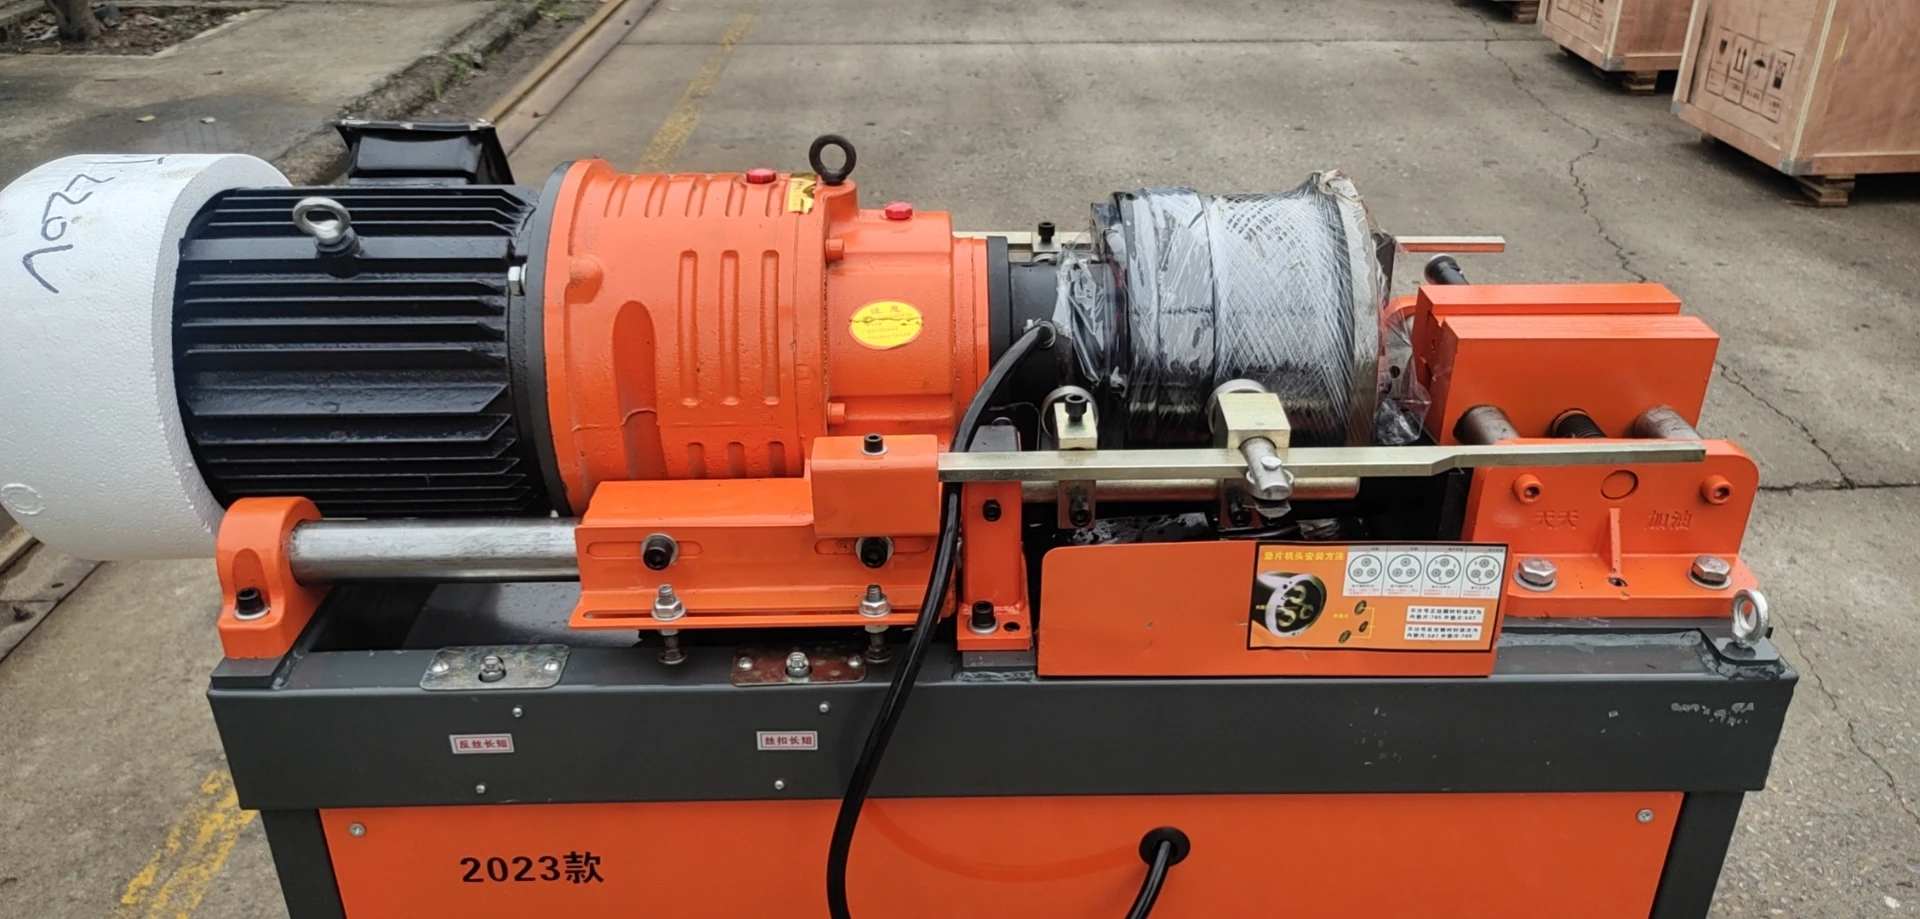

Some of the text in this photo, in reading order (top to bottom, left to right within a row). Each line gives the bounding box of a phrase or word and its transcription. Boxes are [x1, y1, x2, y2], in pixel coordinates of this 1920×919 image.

[1532, 509, 1692, 530] 天天 加油
[1264, 551, 1344, 561] 垫片机头安装方法
[459, 739, 508, 750] 反丝长短
[764, 735, 813, 746] 丝扣长短
[459, 851, 605, 884] 2023款
